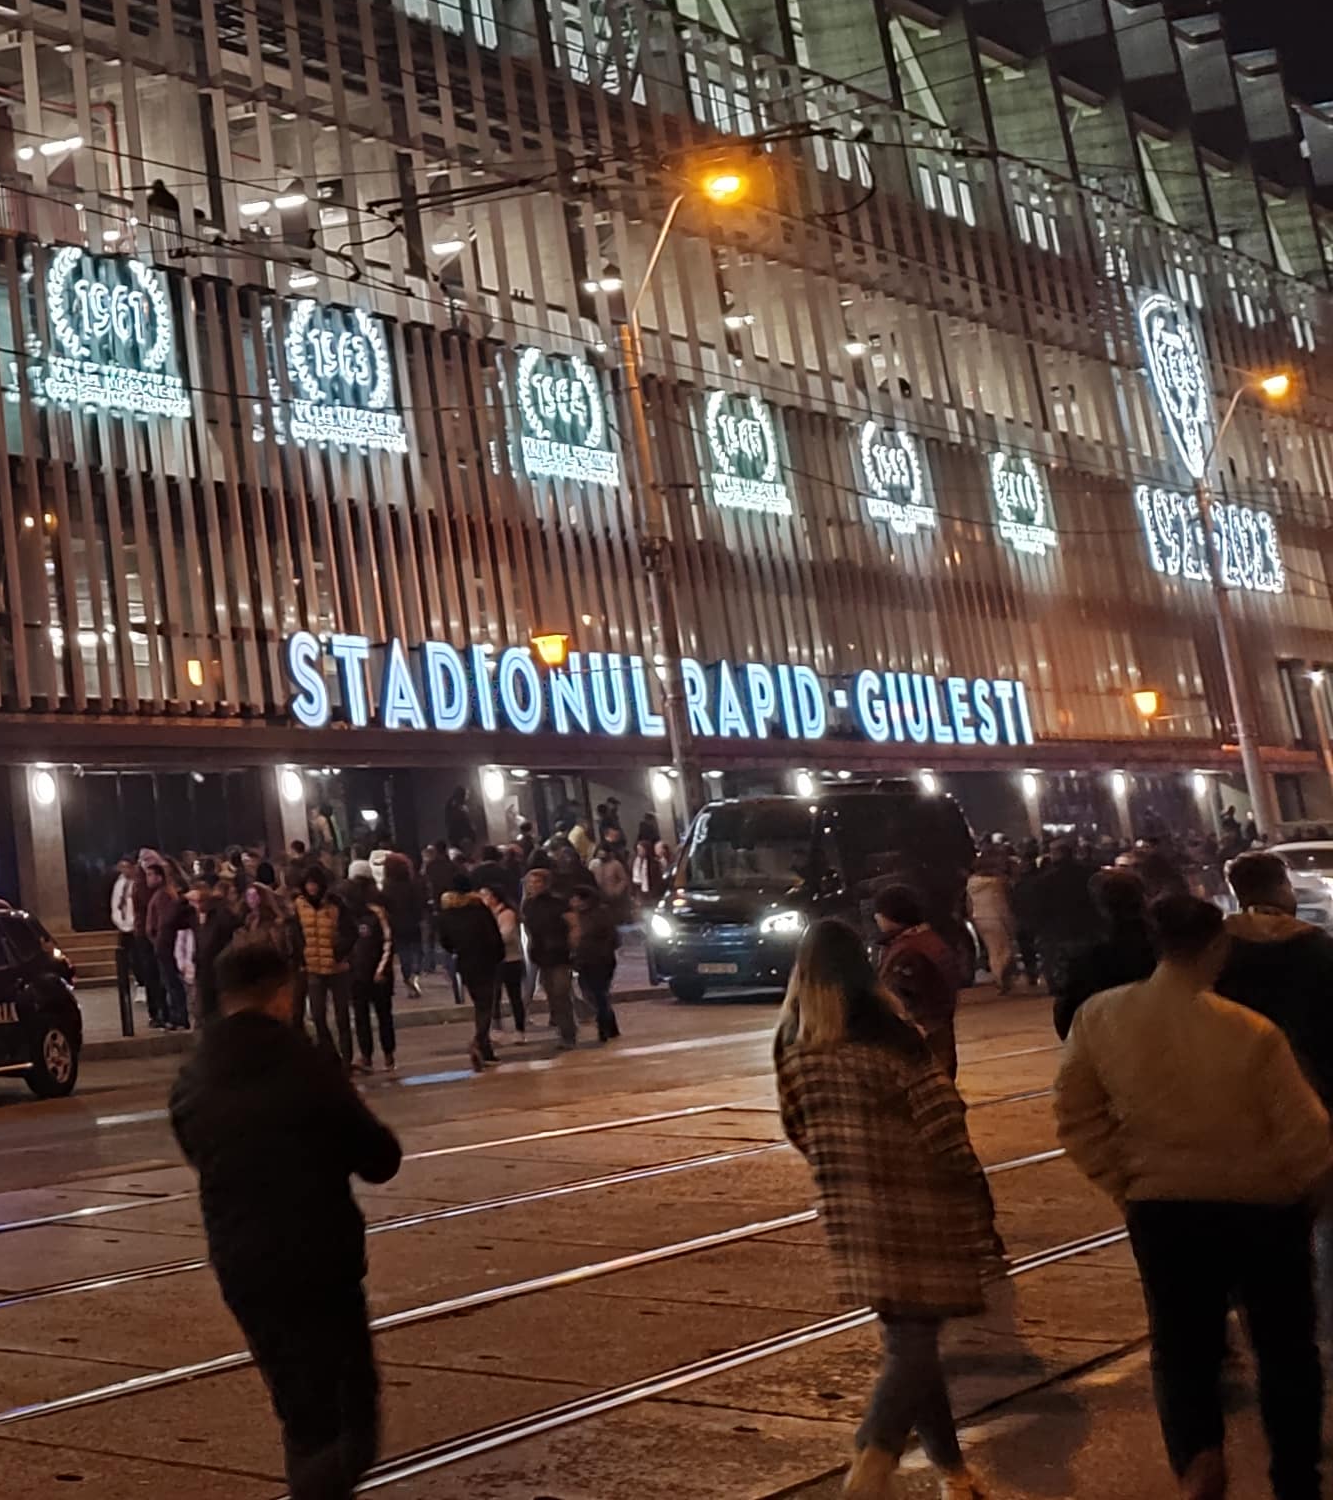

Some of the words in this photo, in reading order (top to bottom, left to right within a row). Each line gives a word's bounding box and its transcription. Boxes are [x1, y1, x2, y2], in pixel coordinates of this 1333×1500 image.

[74, 279, 146, 344] 1961
[288, 631, 666, 737] STADIONUL
[681, 657, 826, 740] RAPID
[856, 669, 1034, 746] GIULESTI
